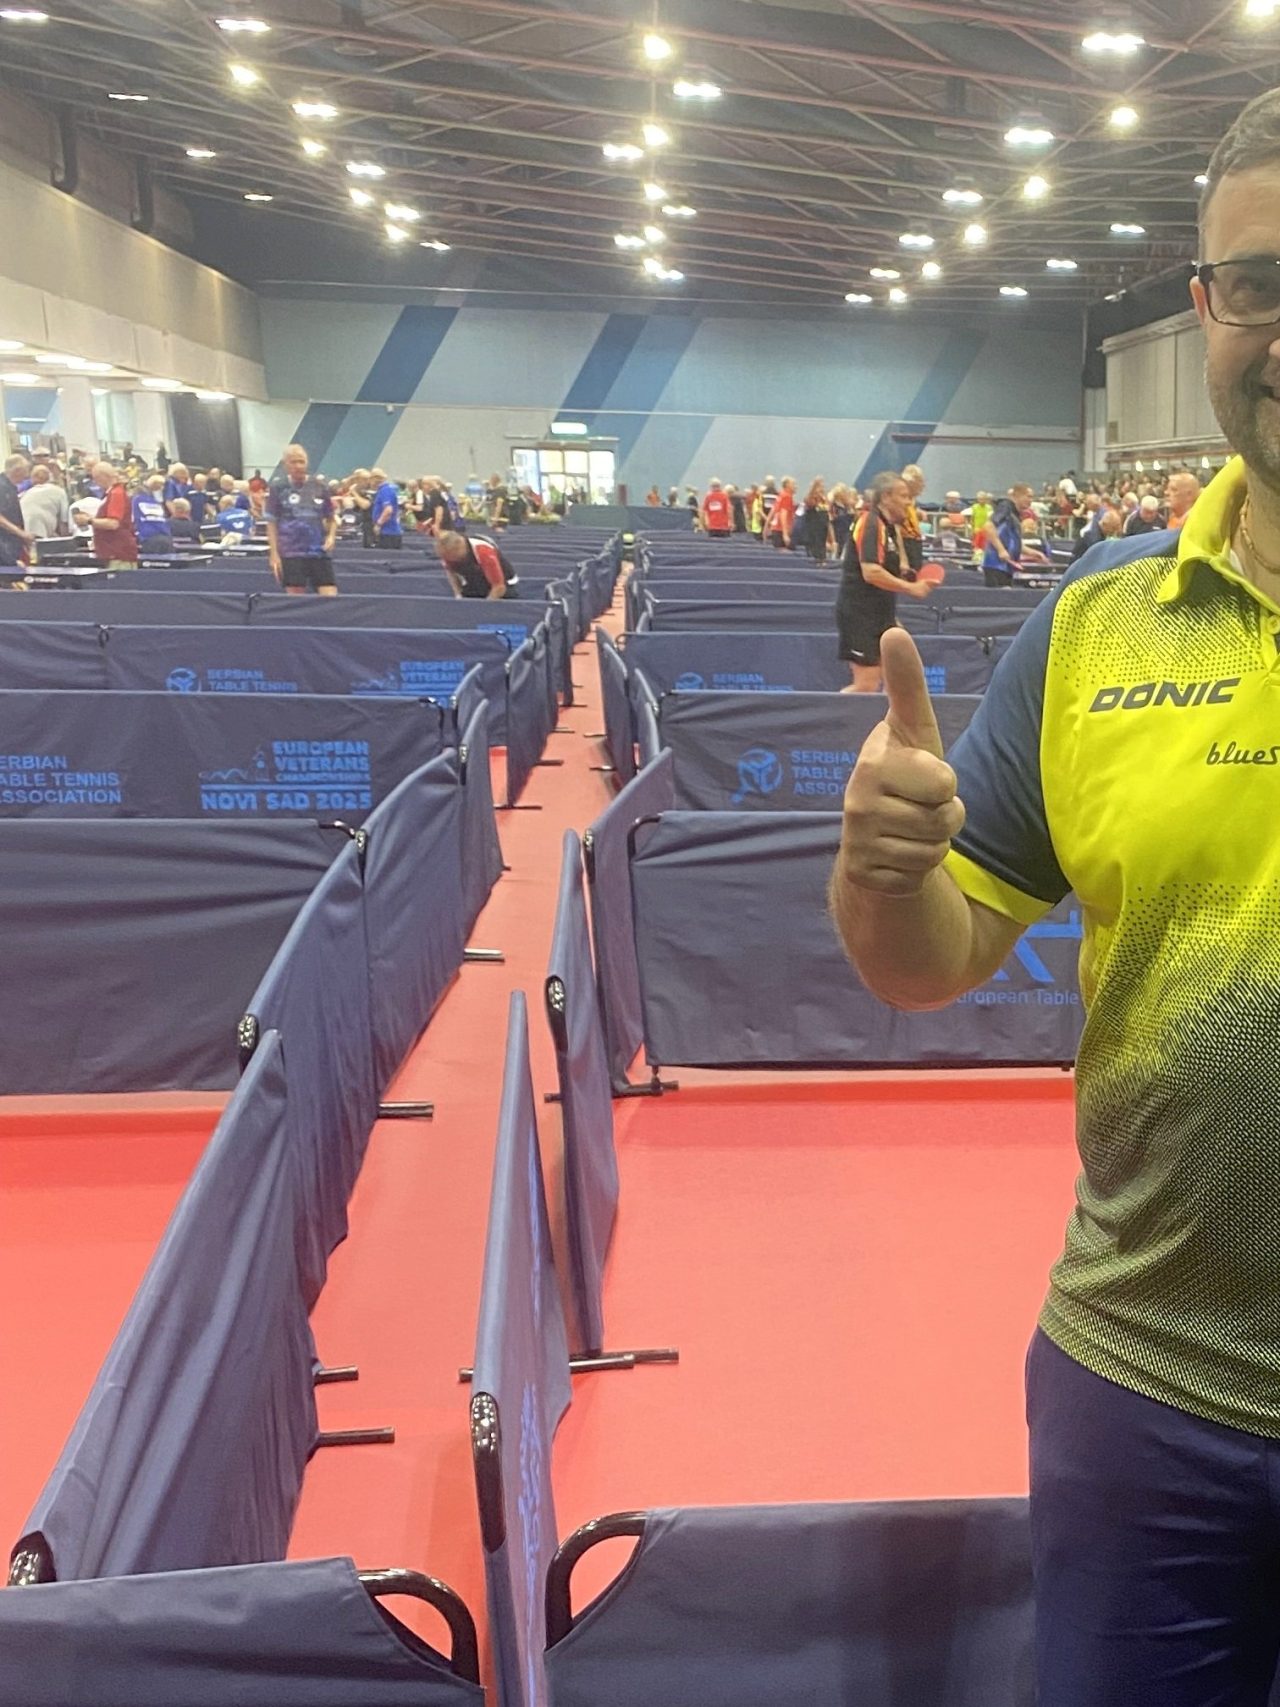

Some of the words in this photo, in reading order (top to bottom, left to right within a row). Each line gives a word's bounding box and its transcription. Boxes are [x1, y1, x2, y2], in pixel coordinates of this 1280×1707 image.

[1088, 678, 1241, 713] DONIC
[272, 741, 369, 755] EUROPEAN
[0, 755, 68, 770] ERBIAN
[274, 756, 369, 771] VETERANS
[0, 772, 47, 787] ABLE
[51, 772, 120, 787] TENNIS
[1, 789, 122, 804] SSOCIATION
[201, 792, 258, 810] NOVI
[266, 792, 310, 810] SAD
[315, 792, 372, 810] 2025
[957, 989, 1029, 1005] uropean
[1037, 989, 1080, 1005] Table
